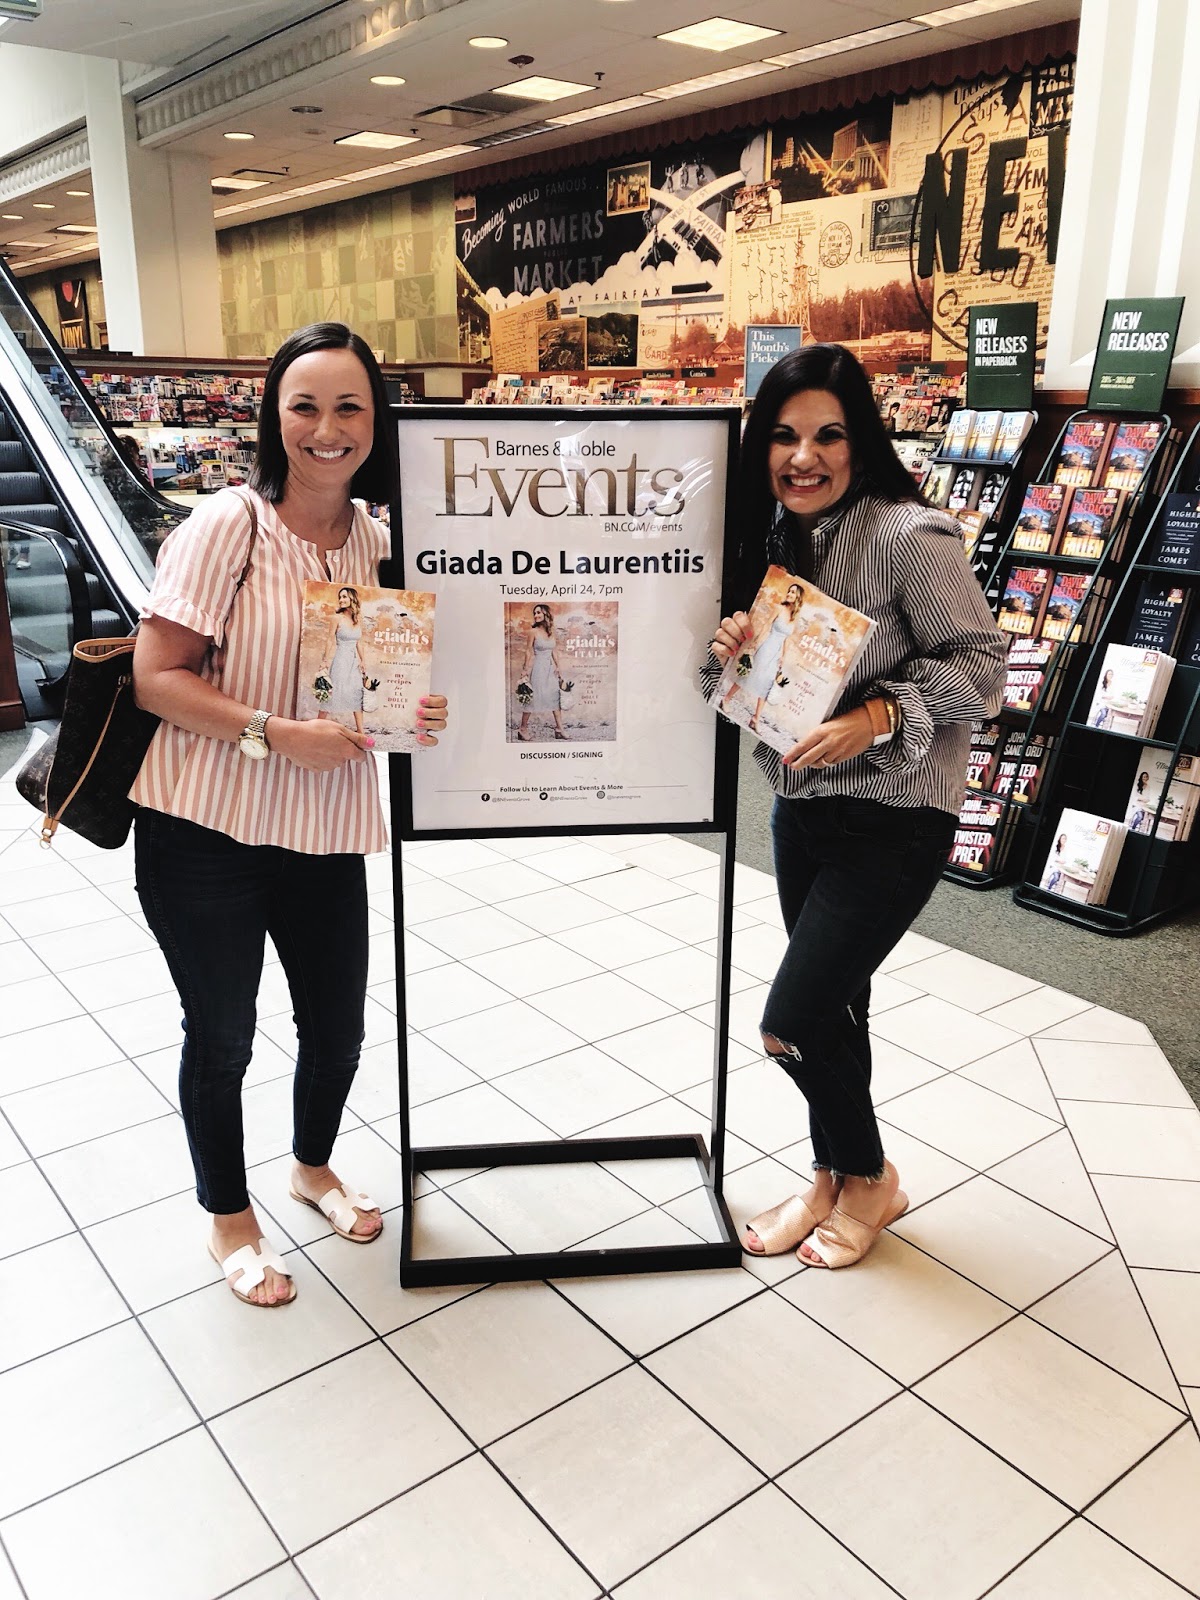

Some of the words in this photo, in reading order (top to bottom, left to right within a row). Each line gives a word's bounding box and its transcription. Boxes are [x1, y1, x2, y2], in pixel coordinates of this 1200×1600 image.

[461, 208, 506, 262] Becoming
[508, 188, 540, 214] WORLD
[513, 209, 604, 251] FARMERS
[694, 215, 726, 248] FAIRFAX
[513, 255, 603, 293] MARKET
[569, 295, 582, 305] AT
[594, 287, 661, 302] FAIRFAX
[975, 318, 998, 336] NEW
[1111, 311, 1142, 330] NEW
[62, 325, 86, 349] VINYL
[751, 330, 775, 342] This
[975, 336, 1028, 354] RELEASES
[1107, 332, 1170, 351] RELEASES
[751, 341, 790, 353] Month's
[750, 352, 779, 364] Picks
[975, 356, 982, 366] IN
[982, 355, 1017, 366] PAPERBACK
[1000, 425, 1022, 436] JANCE
[496, 440, 549, 457] Barnes
[553, 440, 563, 457] &
[434, 437, 686, 518] Events
[1054, 468, 1093, 487] FALLEN
[604, 521, 683, 534] BN.COM/events
[1166, 520, 1200, 529] LOYALTY
[1012, 531, 1051, 553] FALLEN
[1061, 537, 1104, 559] FALLEN
[1161, 545, 1191, 555] JAMES
[416, 548, 503, 575] Giada
[511, 549, 551, 575] De
[559, 547, 704, 575] Laurentiis
[1157, 555, 1189, 565] COMEY
[500, 584, 549, 597] Tuesday,
[551, 584, 577, 597] April
[580, 584, 596, 597] 24,
[598, 584, 623, 598] 7pm
[1143, 598, 1175, 608] HIGHER
[1140, 607, 1173, 618] LOYALTY
[998, 611, 1034, 634] FALLEN
[374, 627, 429, 645] giada's
[566, 634, 616, 652] giada's
[1011, 638, 1035, 651] JOHN
[1134, 632, 1165, 643] JAMES
[799, 634, 847, 668] giada's
[1008, 651, 1049, 664] SANDFORD
[1003, 685, 1033, 703] PREY
[520, 752, 566, 760] DISCUSSION
[572, 751, 603, 760] SIGNING
[961, 799, 982, 812] JOHN
[959, 812, 998, 826] SANDFORD
[953, 830, 992, 846] TWISTED
[952, 845, 984, 864] PREY
